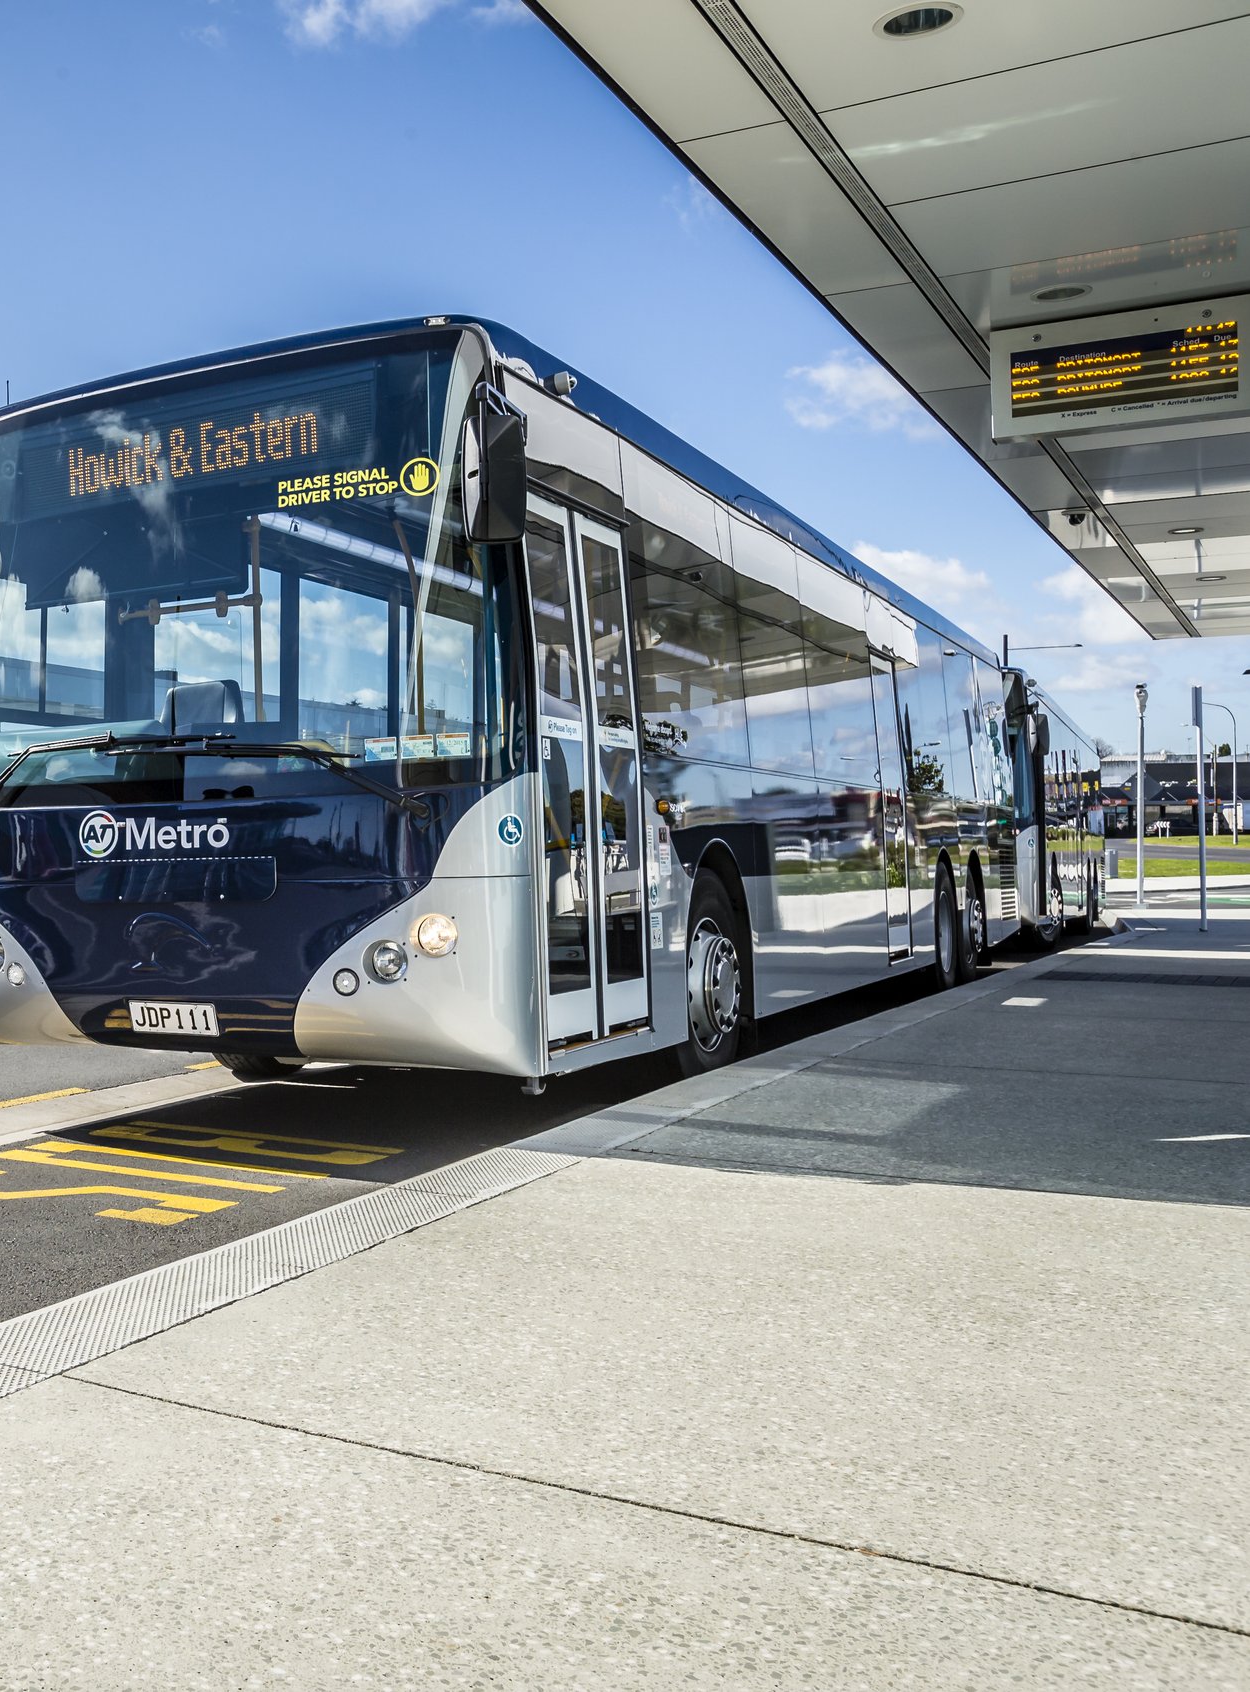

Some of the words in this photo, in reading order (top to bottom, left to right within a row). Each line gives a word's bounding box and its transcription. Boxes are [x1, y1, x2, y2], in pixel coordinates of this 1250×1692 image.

[1172, 338, 1200, 348] Sched
[1214, 334, 1231, 342] Due
[1015, 360, 1039, 368] Route
[1060, 351, 1106, 362] Destination
[1122, 403, 1154, 411] Cancelled
[1190, 394, 1237, 404] due/departing
[1072, 410, 1097, 418] Express
[68, 432, 163, 497] Howick
[170, 428, 193, 478] &
[200, 411, 318, 473] Eastern
[278, 475, 330, 494] PLEASE
[334, 467, 389, 485] SIGNAL
[278, 489, 330, 508] DRIVER
[333, 486, 354, 500] TO
[358, 481, 398, 498] STOP
[135, 1006, 211, 1031] JDP111
